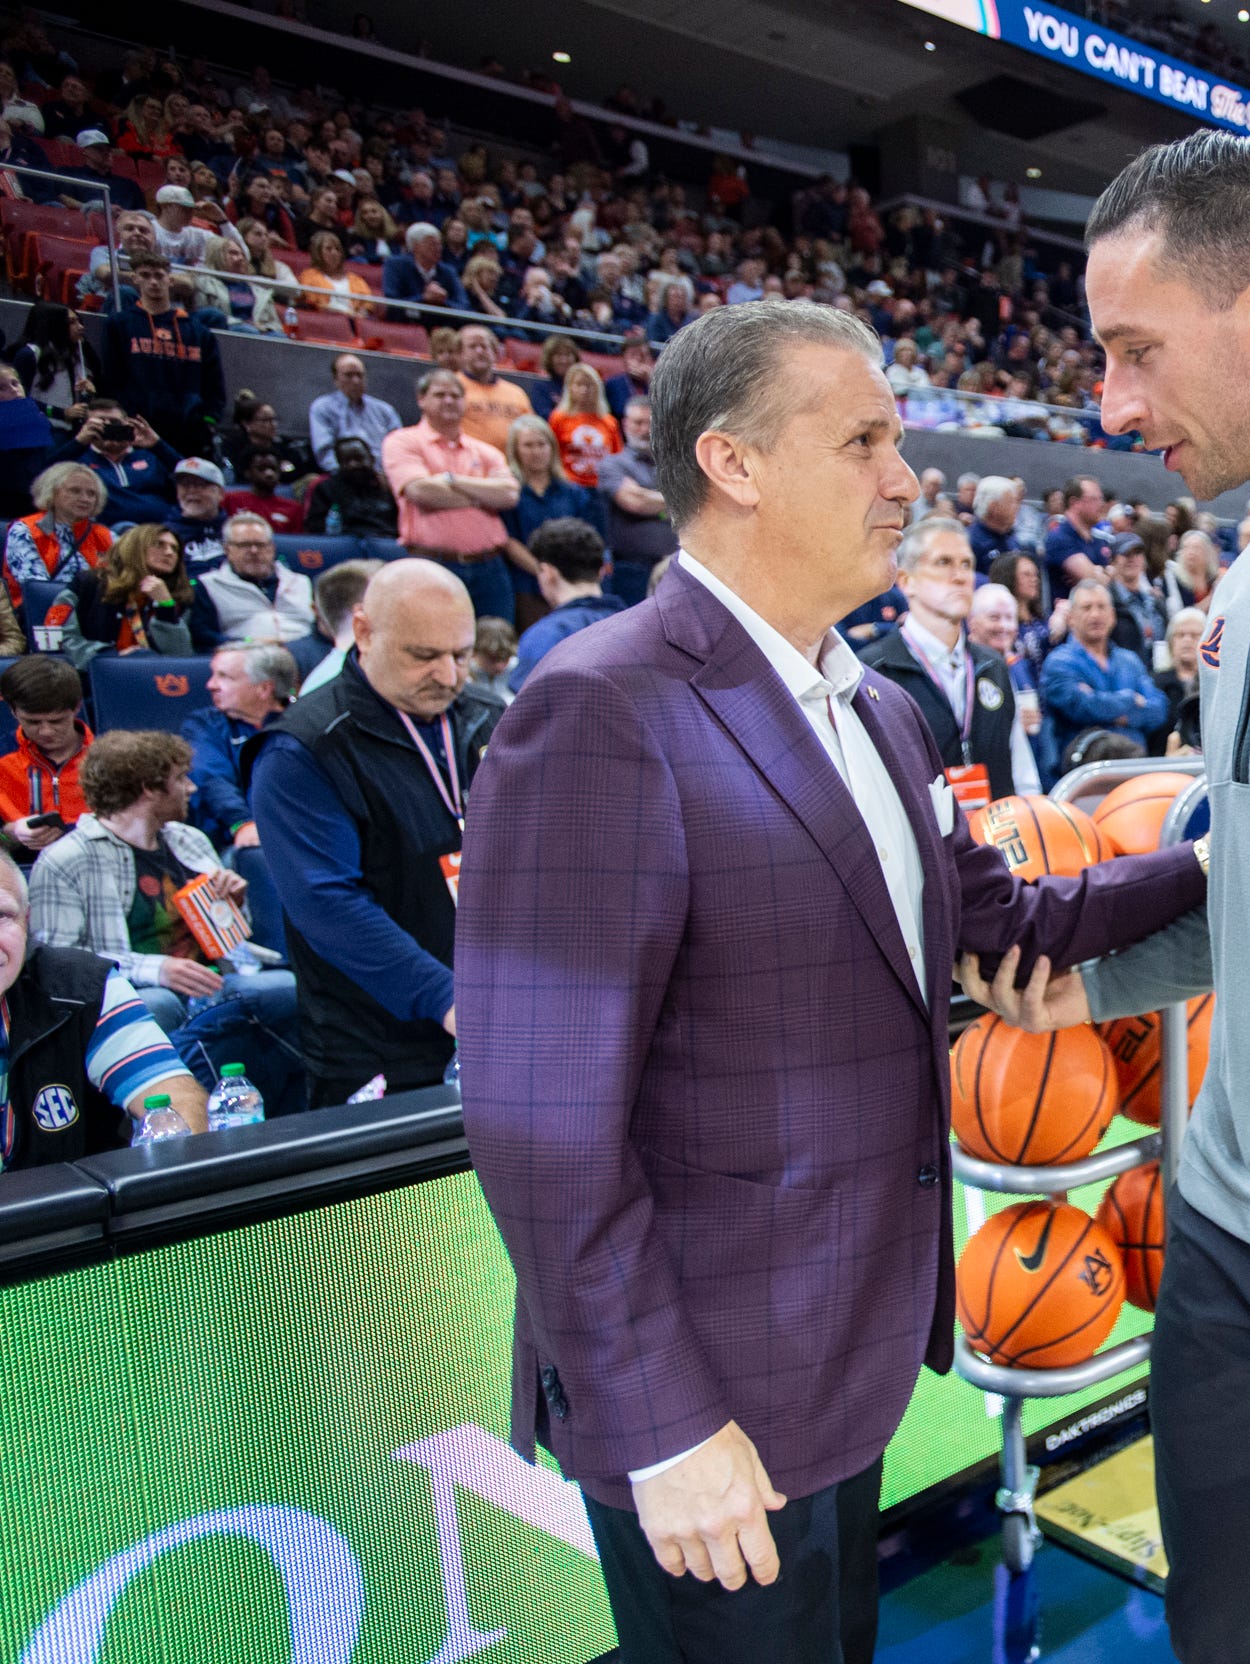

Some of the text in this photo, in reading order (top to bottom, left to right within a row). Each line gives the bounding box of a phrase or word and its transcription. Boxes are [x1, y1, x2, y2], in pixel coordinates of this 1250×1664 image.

[1023, 6, 1079, 58] YOU
[1084, 34, 1156, 89] CAN'T
[1159, 64, 1209, 110] BEAT
[34, 1087, 77, 1129] SEC
